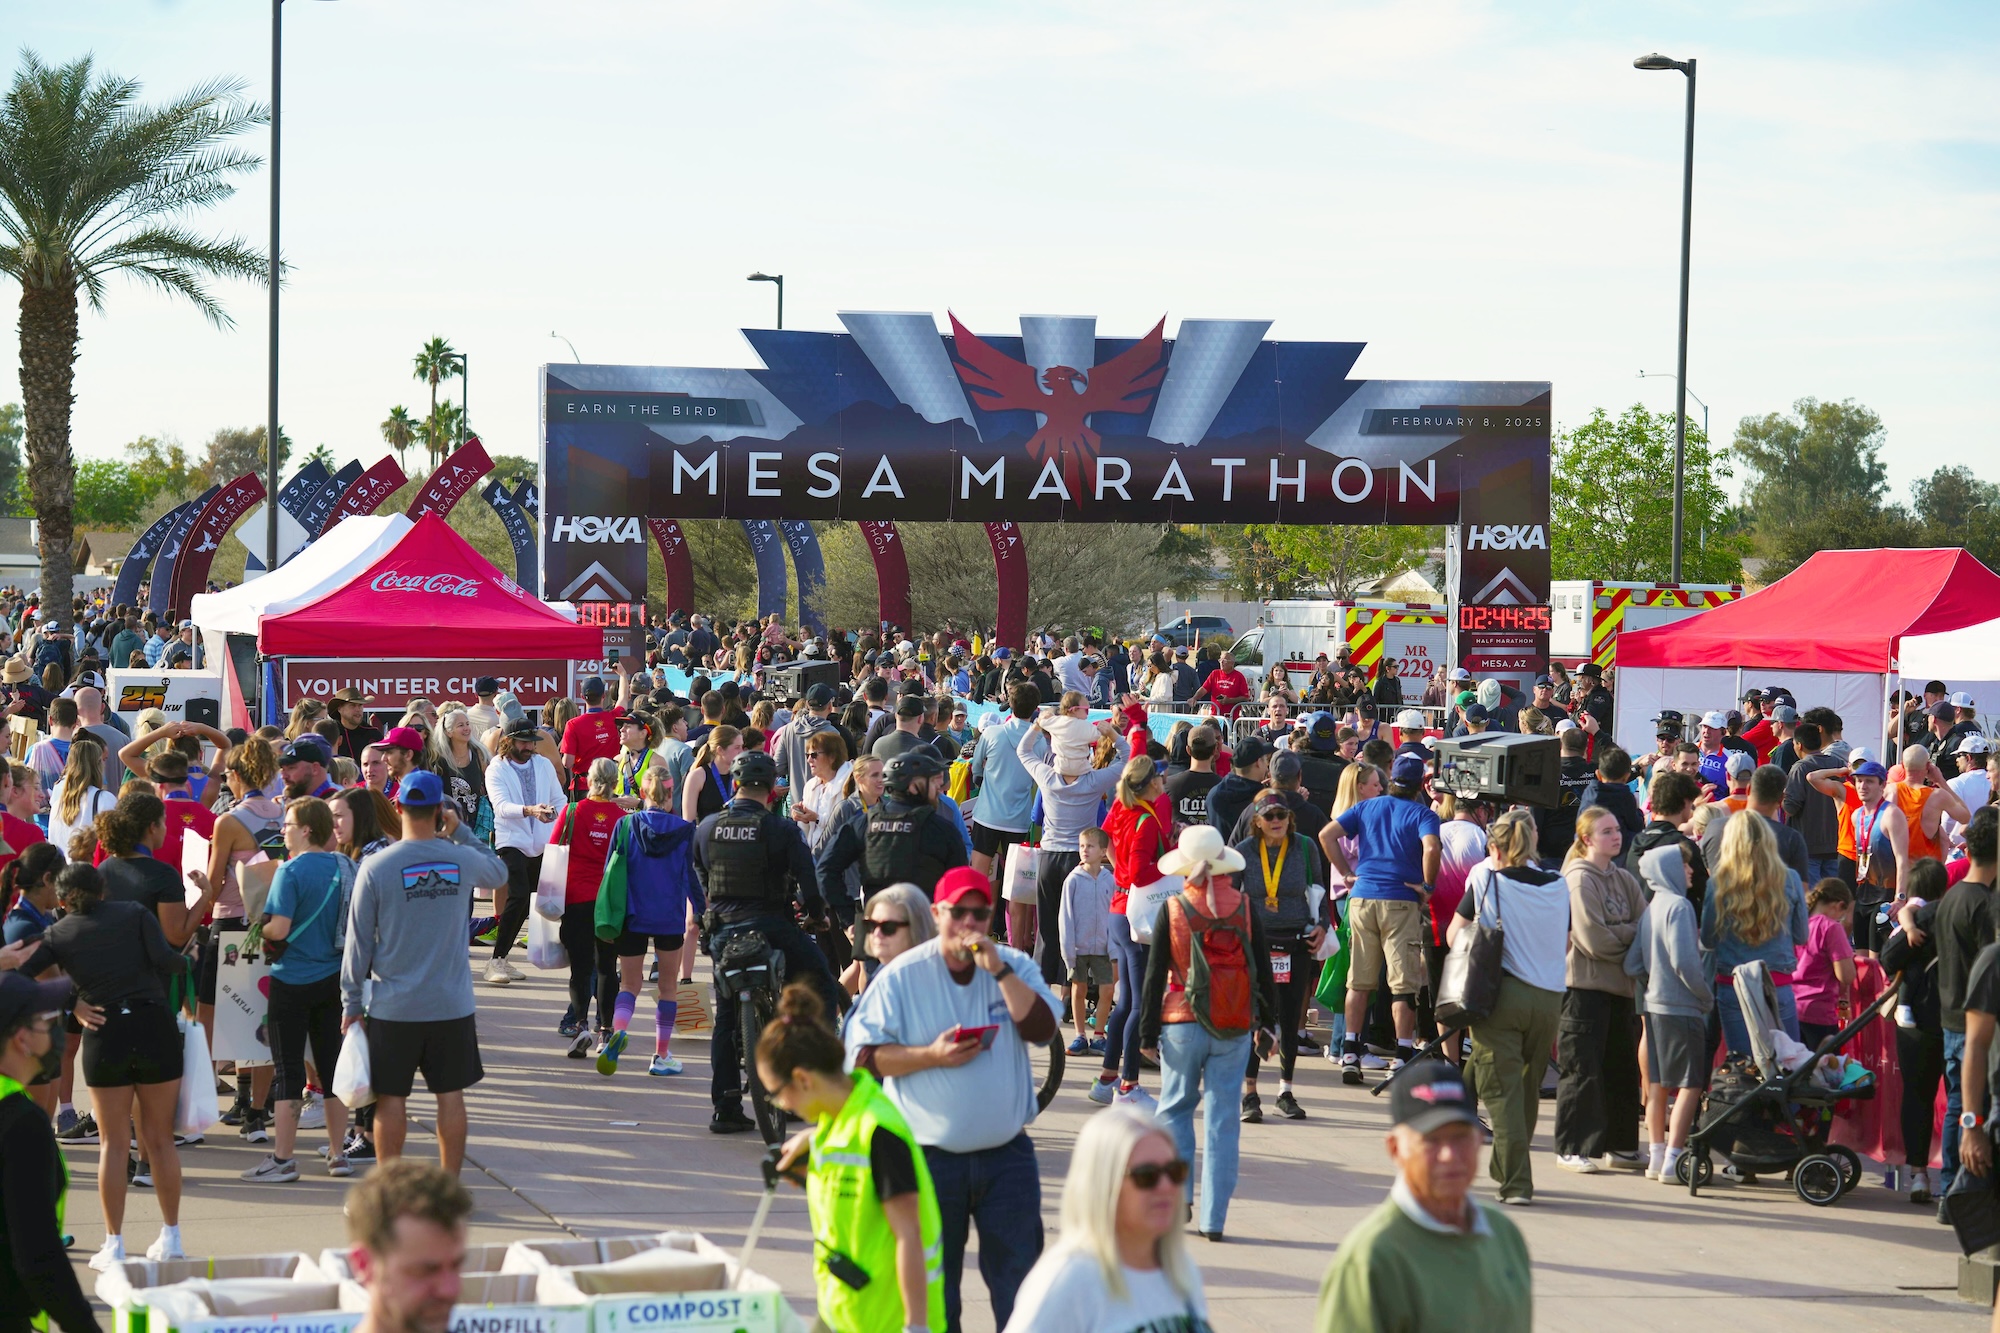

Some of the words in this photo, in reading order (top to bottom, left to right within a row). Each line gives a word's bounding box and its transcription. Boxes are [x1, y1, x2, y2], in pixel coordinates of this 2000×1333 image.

[567, 403, 616, 414] EARN
[629, 404, 660, 415] THE
[672, 406, 717, 417] BIRD
[1392, 417, 1474, 426] FEBRUARY
[1483, 418, 1496, 427] 8,
[1505, 418, 1542, 427] 2025
[672, 449, 904, 499] MESA
[960, 454, 1436, 503] MARATHON
[279, 478, 310, 508] ESA
[288, 479, 322, 518] RATHON
[306, 479, 347, 524] MESA
[337, 477, 380, 522] MESA
[355, 479, 393, 517] RATHON
[418, 465, 464, 517] MESA
[437, 466, 479, 519] ARATHON
[177, 500, 208, 537] MESA
[208, 487, 246, 528] MESA
[215, 489, 257, 537] MARATHON
[313, 486, 349, 535] MARATHO
[146, 511, 182, 542] MESA
[500, 508, 522, 555] MARATHON
[508, 506, 529, 547] MESA
[551, 515, 643, 543] HOKA
[652, 519, 675, 556] RATHON
[662, 519, 682, 545] SA
[745, 519, 765, 553] ATHON
[758, 520, 773, 543] SA
[782, 520, 803, 557] ATHON
[795, 522, 810, 545] SA
[866, 521, 887, 555] THON
[878, 520, 895, 543] SA
[1002, 521, 1018, 547] SA
[1467, 524, 1546, 550] HOKA
[370, 570, 483, 598] Coca-Cola
[576, 602, 646, 627] :00:01
[1460, 606, 1550, 630] 02:44:25
[1405, 645, 1428, 657] MR
[1481, 660, 1509, 668] MESA,
[1513, 660, 1527, 668] AZ
[1398, 659, 1434, 678] 229
[117, 685, 168, 712] 25
[297, 678, 440, 696] VOLUNTEER
[446, 676, 558, 694] CHCK-IN
[1698, 757, 1721, 767] gna
[1560, 779, 1591, 787] Engineerin
[589, 830, 608, 839] HOKA
[714, 826, 757, 841] POLICE
[871, 821, 912, 833] POLICE
[406, 887, 458, 902] patagonia
[1270, 962, 1289, 971] 781
[222, 984, 232, 994] GO
[231, 992, 255, 1017] KAYLA!
[627, 1299, 742, 1324] COMPOST
[455, 1317, 546, 1333] ANDFILL
